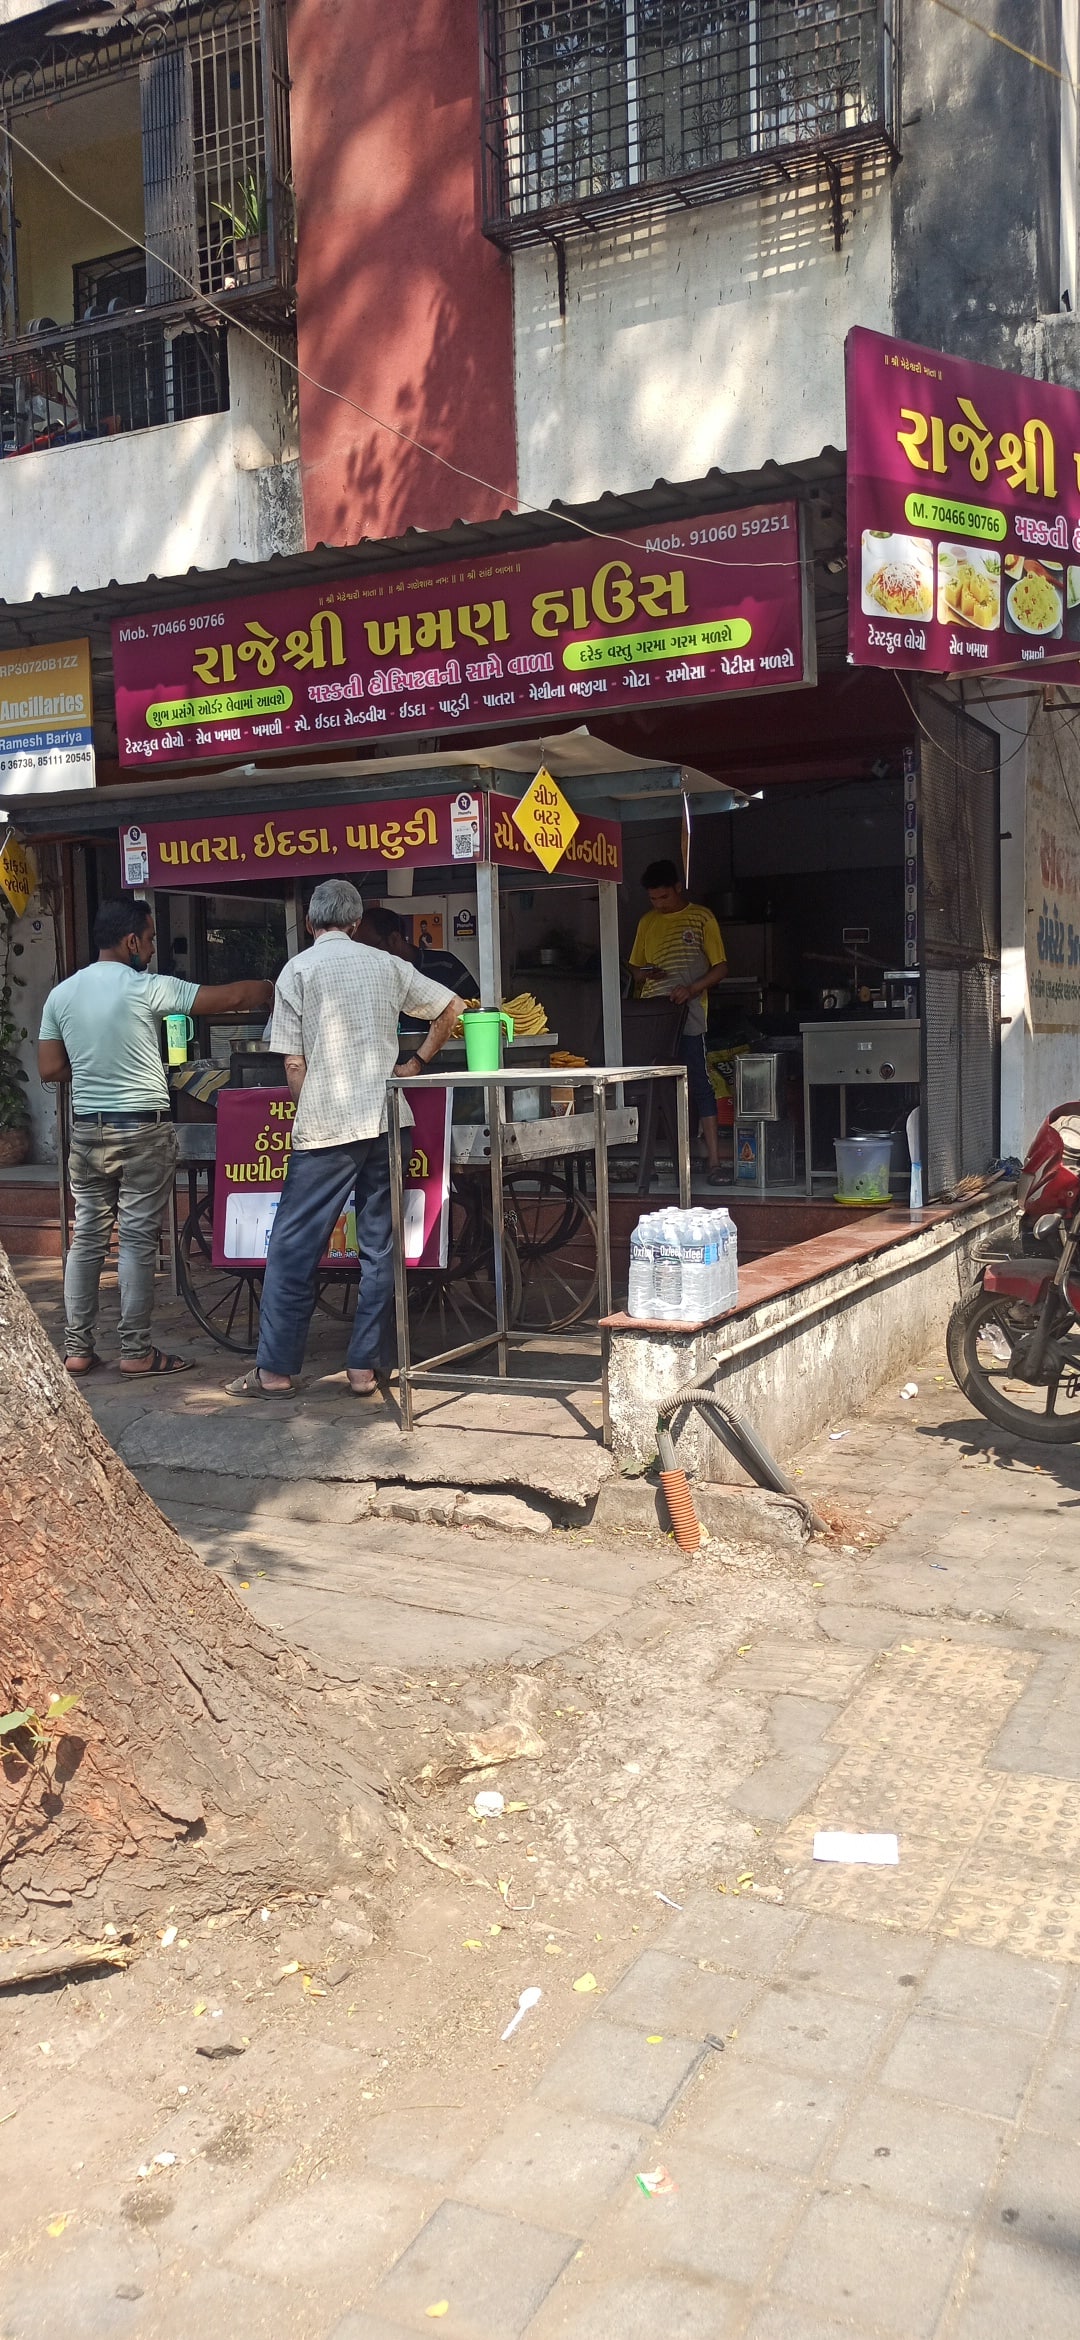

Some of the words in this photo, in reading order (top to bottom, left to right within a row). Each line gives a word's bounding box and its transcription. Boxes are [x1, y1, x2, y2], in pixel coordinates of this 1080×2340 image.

[897, 397, 1058, 498] રાજેશ્રી
[912, 501, 928, 520] M.
[931, 505, 966, 526] 70466
[967, 512, 1000, 533] 90766
[645, 533, 685, 554] Mob.
[689, 523, 737, 546] 91060
[741, 514, 790, 537] 59251
[119, 626, 149, 642] Mob.
[151, 619, 187, 637] 70466
[189, 612, 225, 631] 90766
[192, 609, 347, 685] રાજેશ્રી
[363, 600, 511, 657] ખમણ
[531, 559, 690, 638] હાઉસ
[579, 643, 604, 663] દરેક
[607, 642, 633, 662] વસ્તુ
[635, 637, 666, 654] ગરમા
[670, 633, 697, 649] ગરમ
[701, 624, 733, 644] મળશે
[904, 628, 926, 651] લોચો
[949, 634, 964, 656] સેવ
[966, 641, 989, 659] ખમણ
[367, 659, 462, 697] હોસ્પિટલની
[465, 652, 504, 682] સામે
[507, 651, 555, 675] વાળા
[0, 693, 84, 721] Ancillaries
[152, 710, 169, 727] શુભ
[172, 702, 195, 721] પ્રસંગે
[197, 699, 223, 716] ઓર્ડર
[225, 695, 254, 712] લેવામાં
[256, 689, 286, 708] આવશે
[161, 731, 184, 750] લોચો
[195, 728, 212, 745] સેવ
[214, 727, 241, 743] ખમણ
[251, 718, 283, 737] ખમણી
[343, 705, 387, 726] સેન્ડવીચ
[438, 692, 470, 718] પાટુડી
[482, 691, 516, 707] પાતરા
[528, 681, 566, 701] મેથીના
[569, 678, 608, 698] ભજીયા
[622, 669, 651, 689] ગોટા
[665, 662, 706, 683] સમોસા
[720, 654, 756, 676] પેટીસ
[759, 648, 795, 670] મળશે
[0, 733, 43, 751] Ramesh
[46, 731, 82, 746] Bariya
[37, 755, 63, 767] 85111
[65, 751, 92, 764] 20545
[533, 784, 558, 806] ચીઝ
[533, 809, 561, 826] બટર
[158, 835, 247, 866] પાતરા,
[253, 820, 338, 859] ઈદડા,
[345, 806, 438, 860] પાટુડી
[534, 826, 564, 849] લોચો
